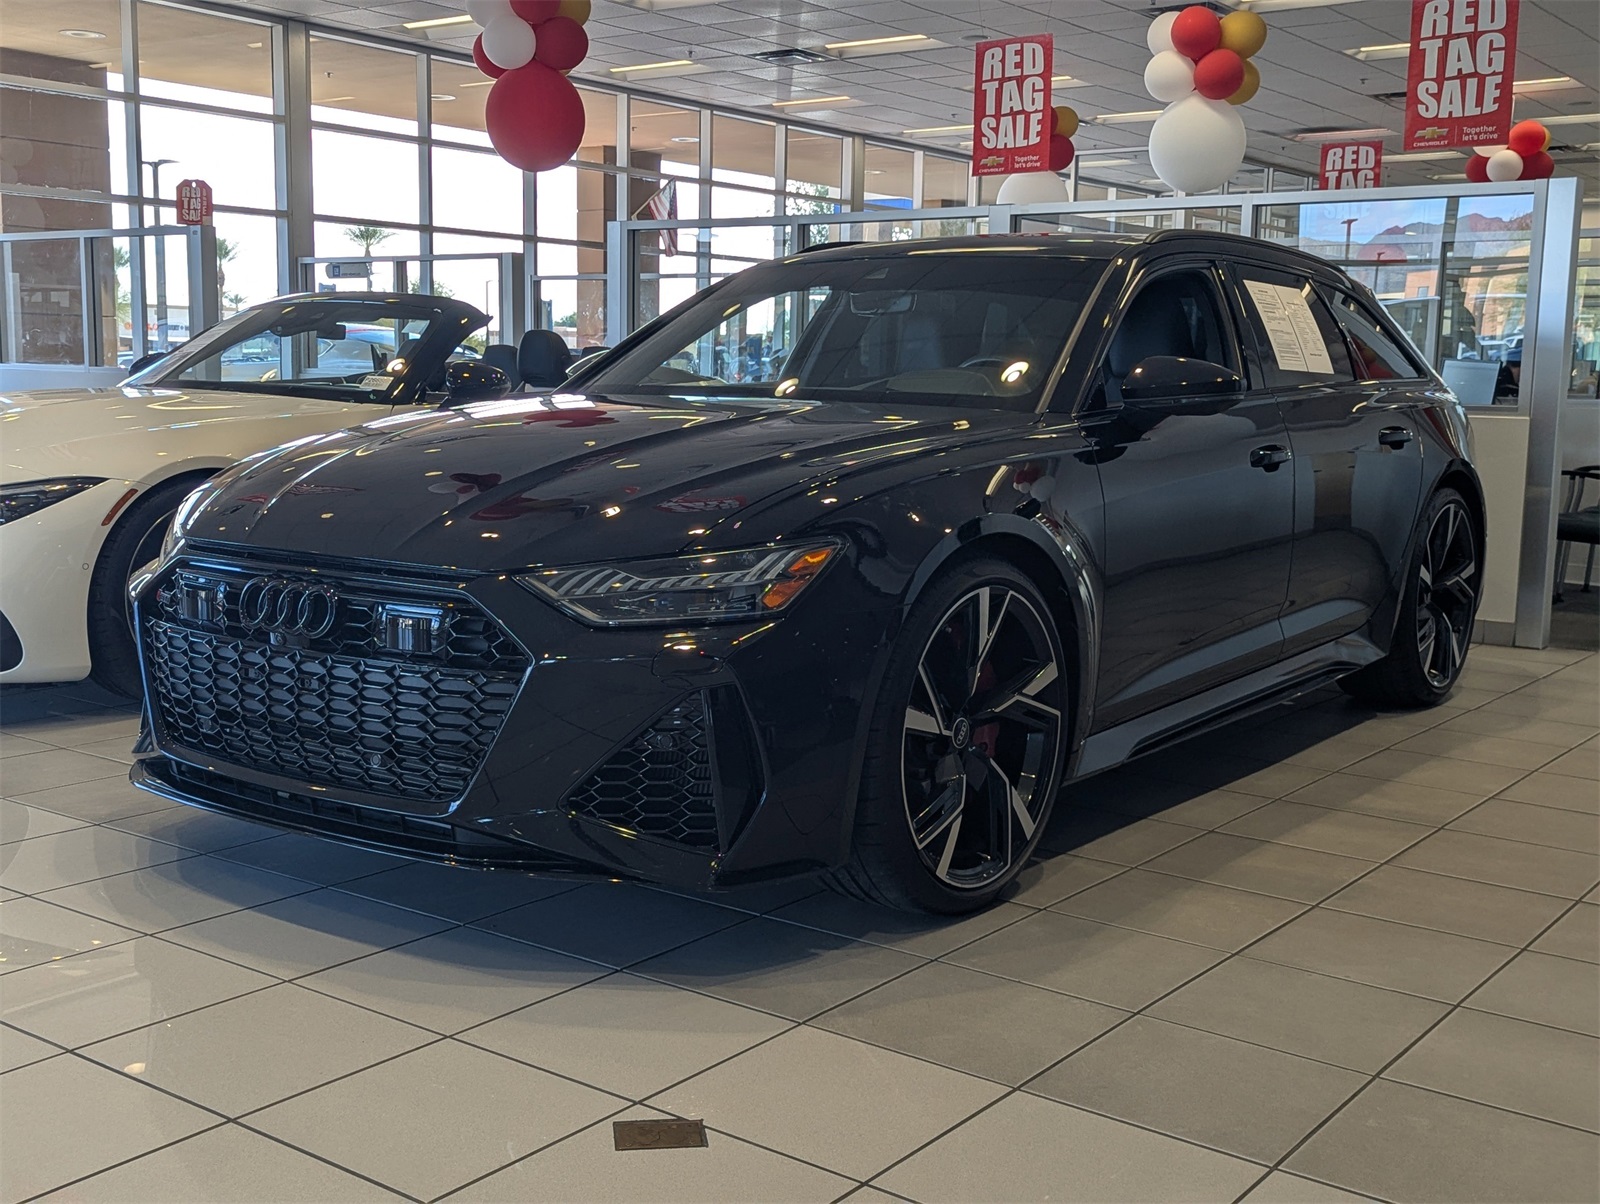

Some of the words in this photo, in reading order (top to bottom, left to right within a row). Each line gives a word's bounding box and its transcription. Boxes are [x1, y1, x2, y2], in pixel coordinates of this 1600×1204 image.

[1420, 0, 1507, 39] RED
[982, 43, 1045, 81] RED
[1419, 32, 1506, 79] TAG
[981, 76, 1044, 116] TAG
[1416, 75, 1503, 119] SALE
[981, 111, 1042, 149] SALE
[1462, 125, 1497, 134] Together
[1462, 133, 1478, 141] let's
[1479, 133, 1498, 141] drive
[1014, 154, 1040, 163] Together
[1325, 145, 1375, 171] RED
[182, 186, 201, 197] RED
[1325, 169, 1375, 191] TAG
[181, 198, 201, 209] TAG
[182, 209, 201, 221] SALE
